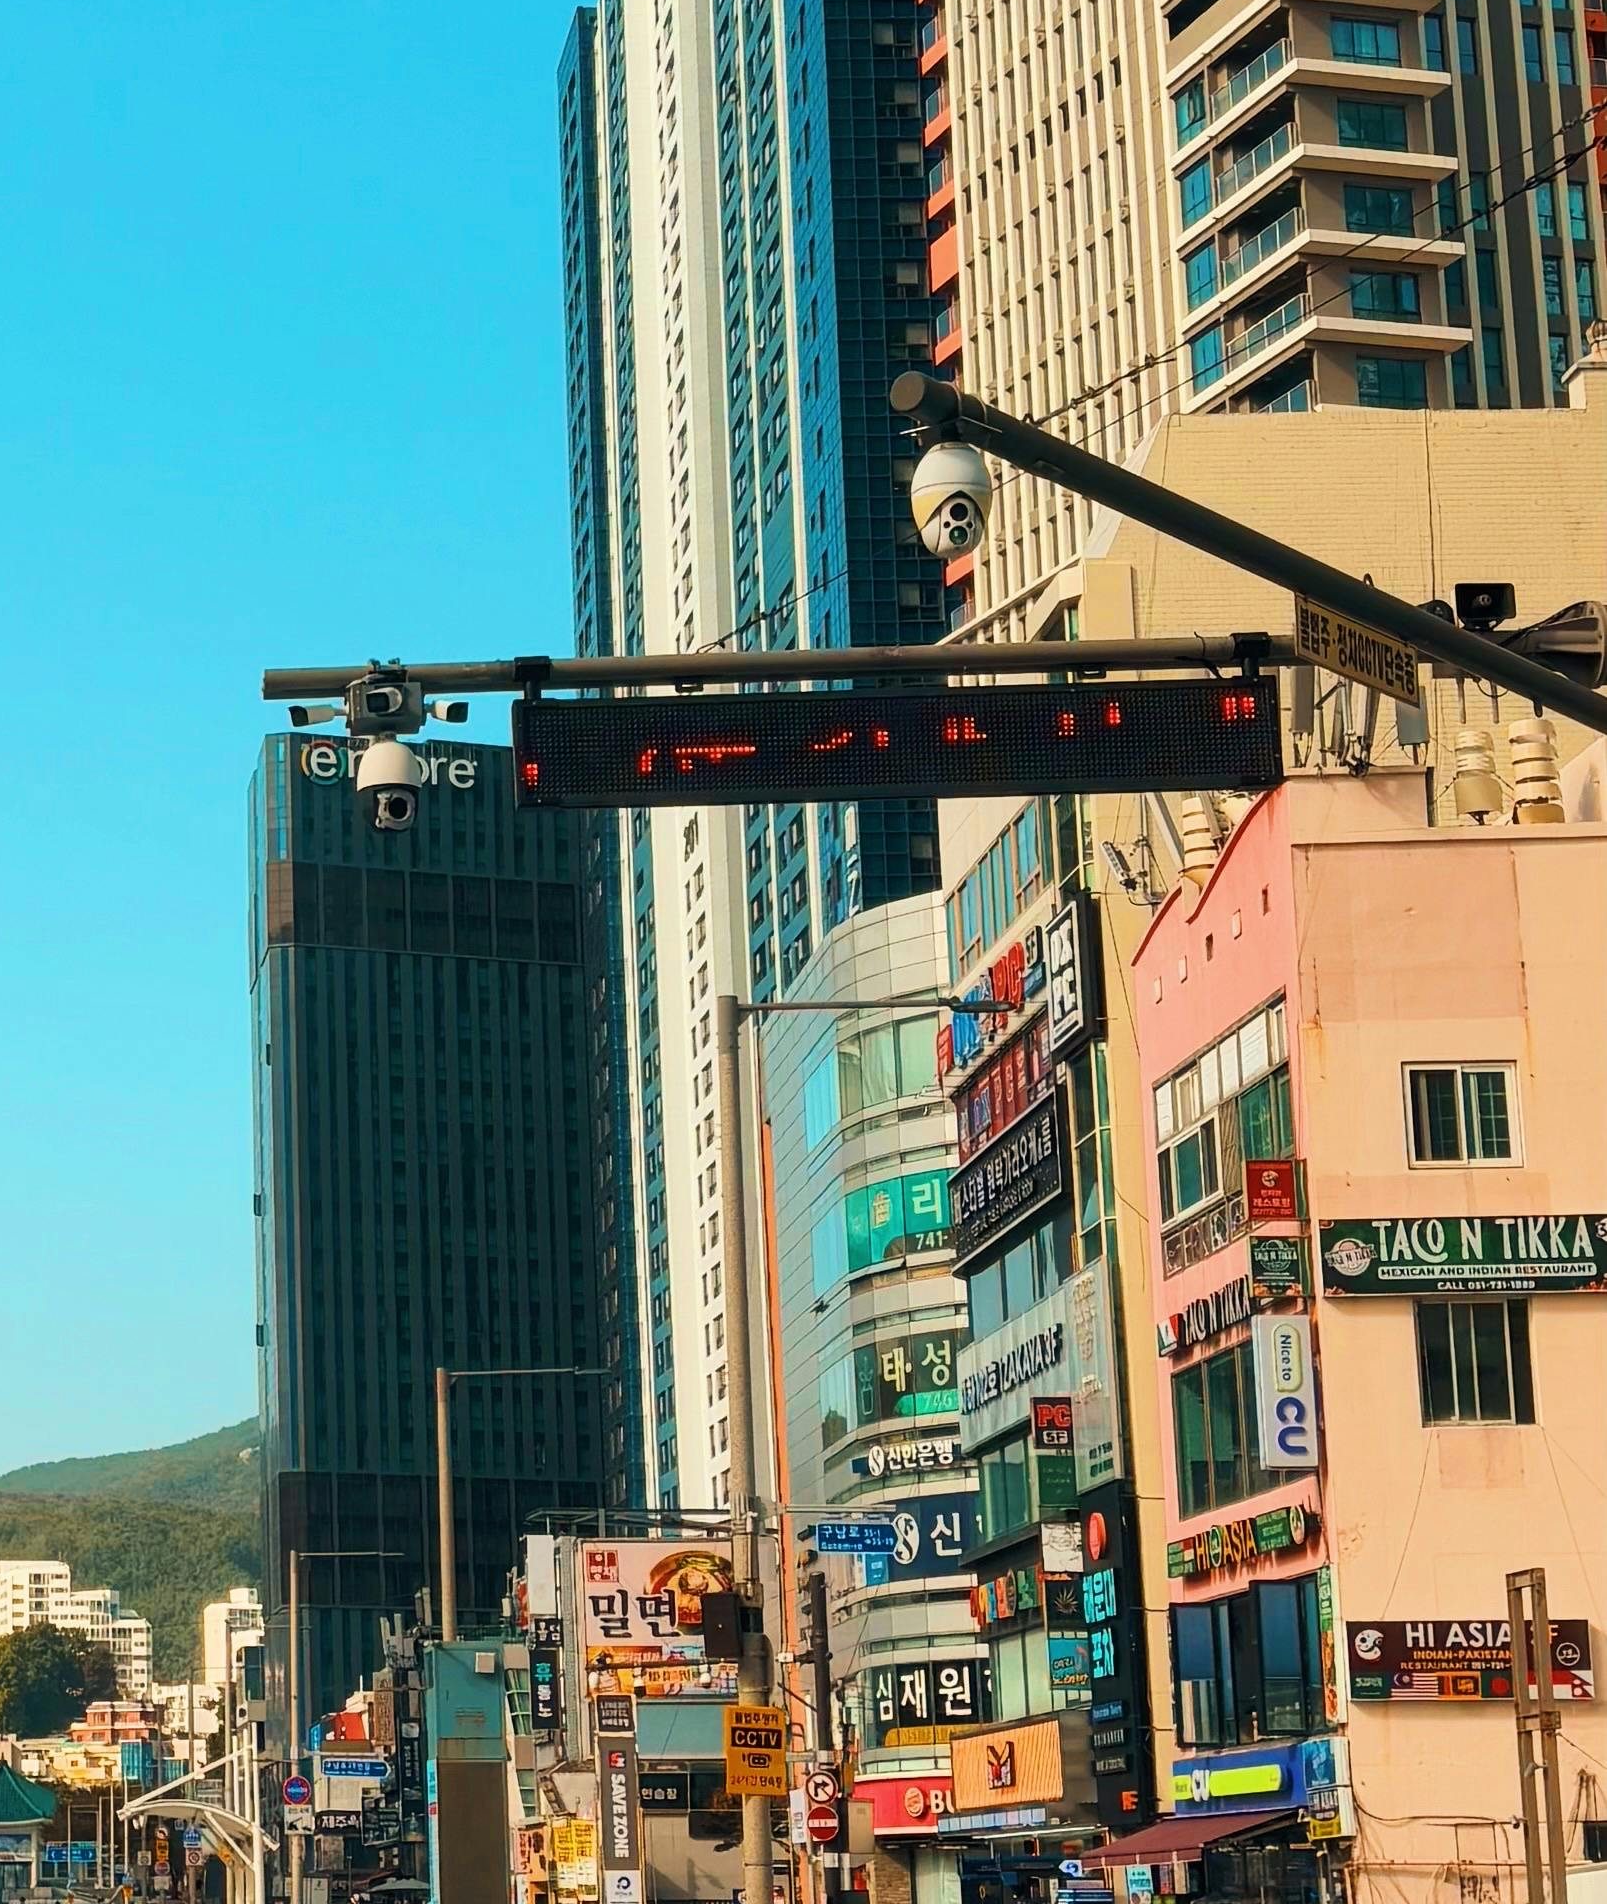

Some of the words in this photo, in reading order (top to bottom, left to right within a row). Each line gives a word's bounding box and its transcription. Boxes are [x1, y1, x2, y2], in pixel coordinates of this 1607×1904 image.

[1371, 1219, 1449, 1264] TACO
[1460, 1218, 1484, 1261] N
[1495, 1215, 1595, 1260] TIKKA
[1381, 1266, 1441, 1277] MEXICAN
[1442, 1265, 1464, 1276] AND
[1469, 1264, 1512, 1276] INDIAN
[1515, 1263, 1594, 1275] RESTAURANT
[1437, 1281, 1465, 1290] CALL
[1037, 1404, 1072, 1428] PC
[1275, 1396, 1308, 1456] CU
[887, 1439, 955, 1470] 신한은행
[1222, 1518, 1258, 1565] ASIA
[588, 1589, 682, 1638] 밀면
[1405, 1622, 1435, 1648] HI
[1446, 1622, 1512, 1648] ASIA
[1400, 1662, 1469, 1671] RESTAURANT
[735, 1730, 778, 1746] CCTV
